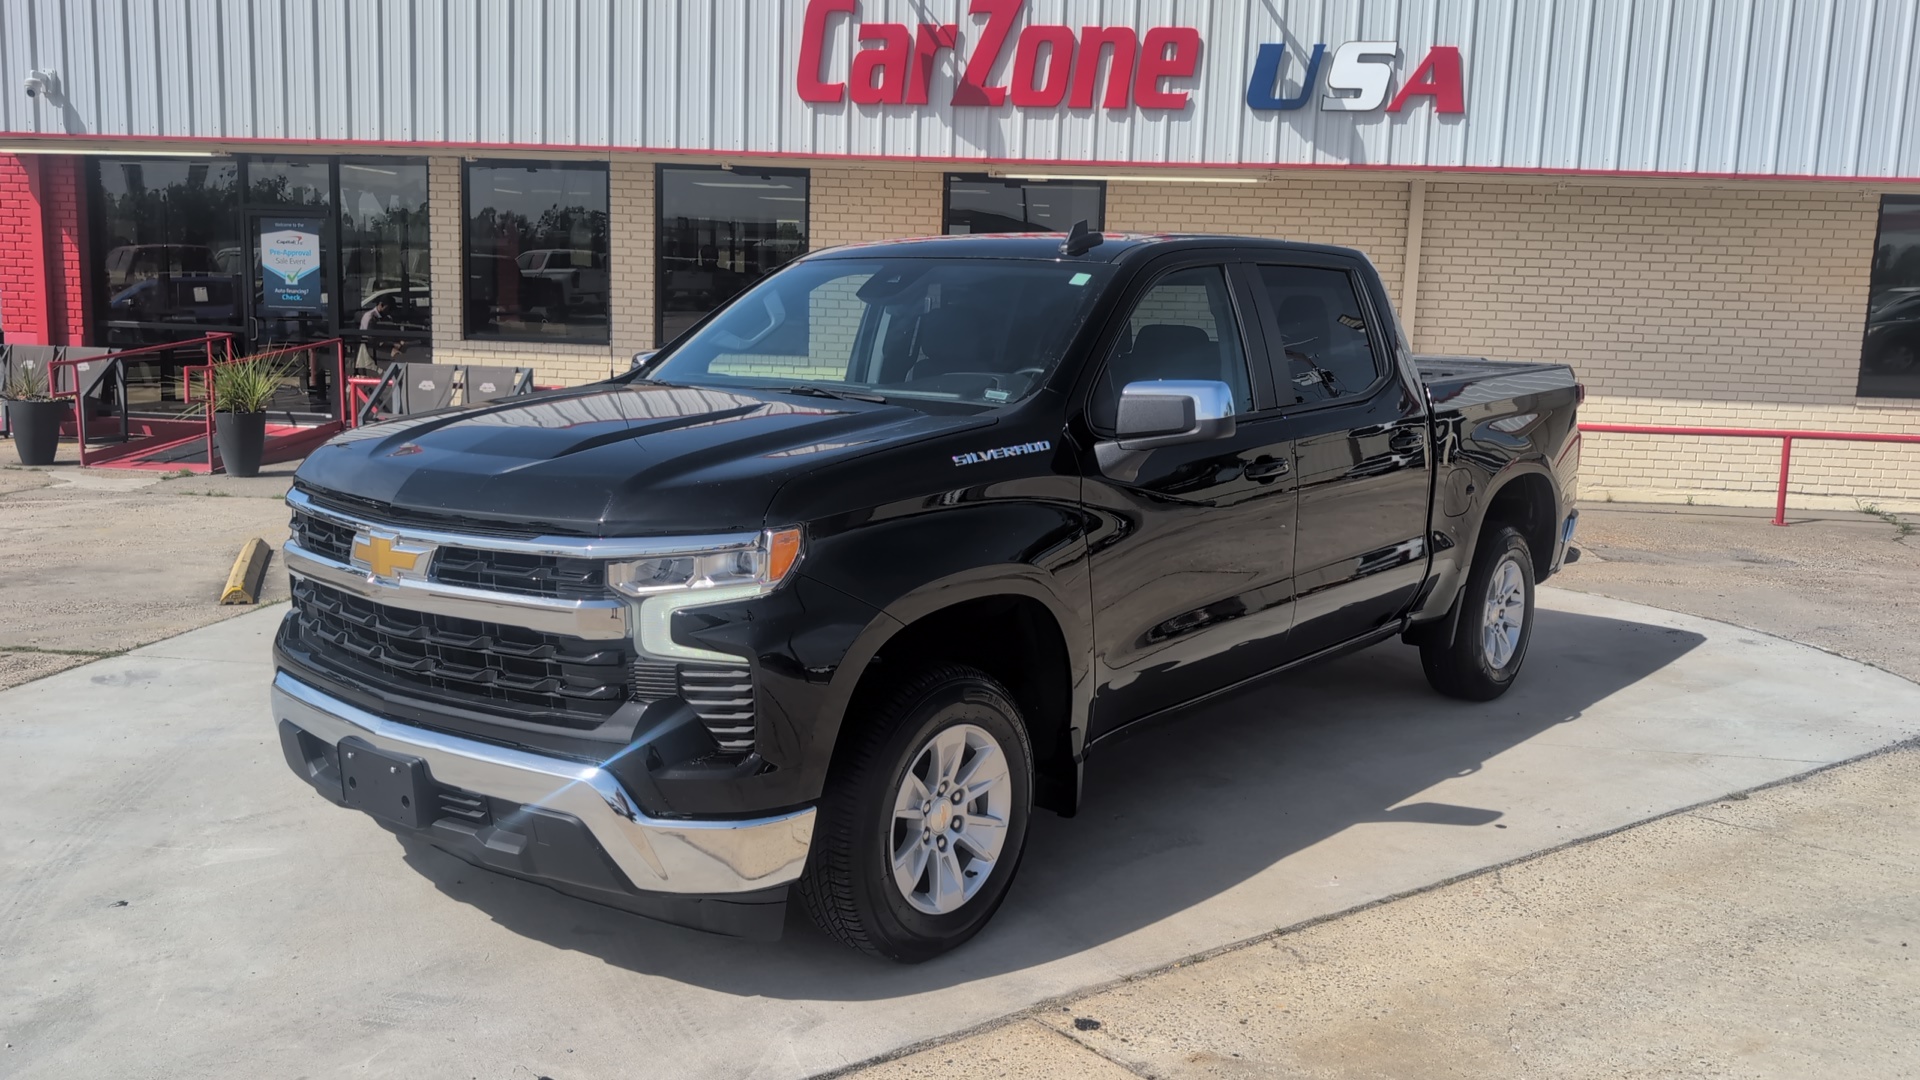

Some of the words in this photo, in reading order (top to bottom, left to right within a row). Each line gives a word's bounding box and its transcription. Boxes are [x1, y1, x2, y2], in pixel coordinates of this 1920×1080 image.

[796, 0, 1200, 110] CarZone
[1246, 41, 1465, 113] USA
[269, 248, 312, 257] Pre-Approval
[275, 257, 288, 265] Sale
[289, 257, 306, 265] Event
[952, 440, 1051, 467] SILVERADO
